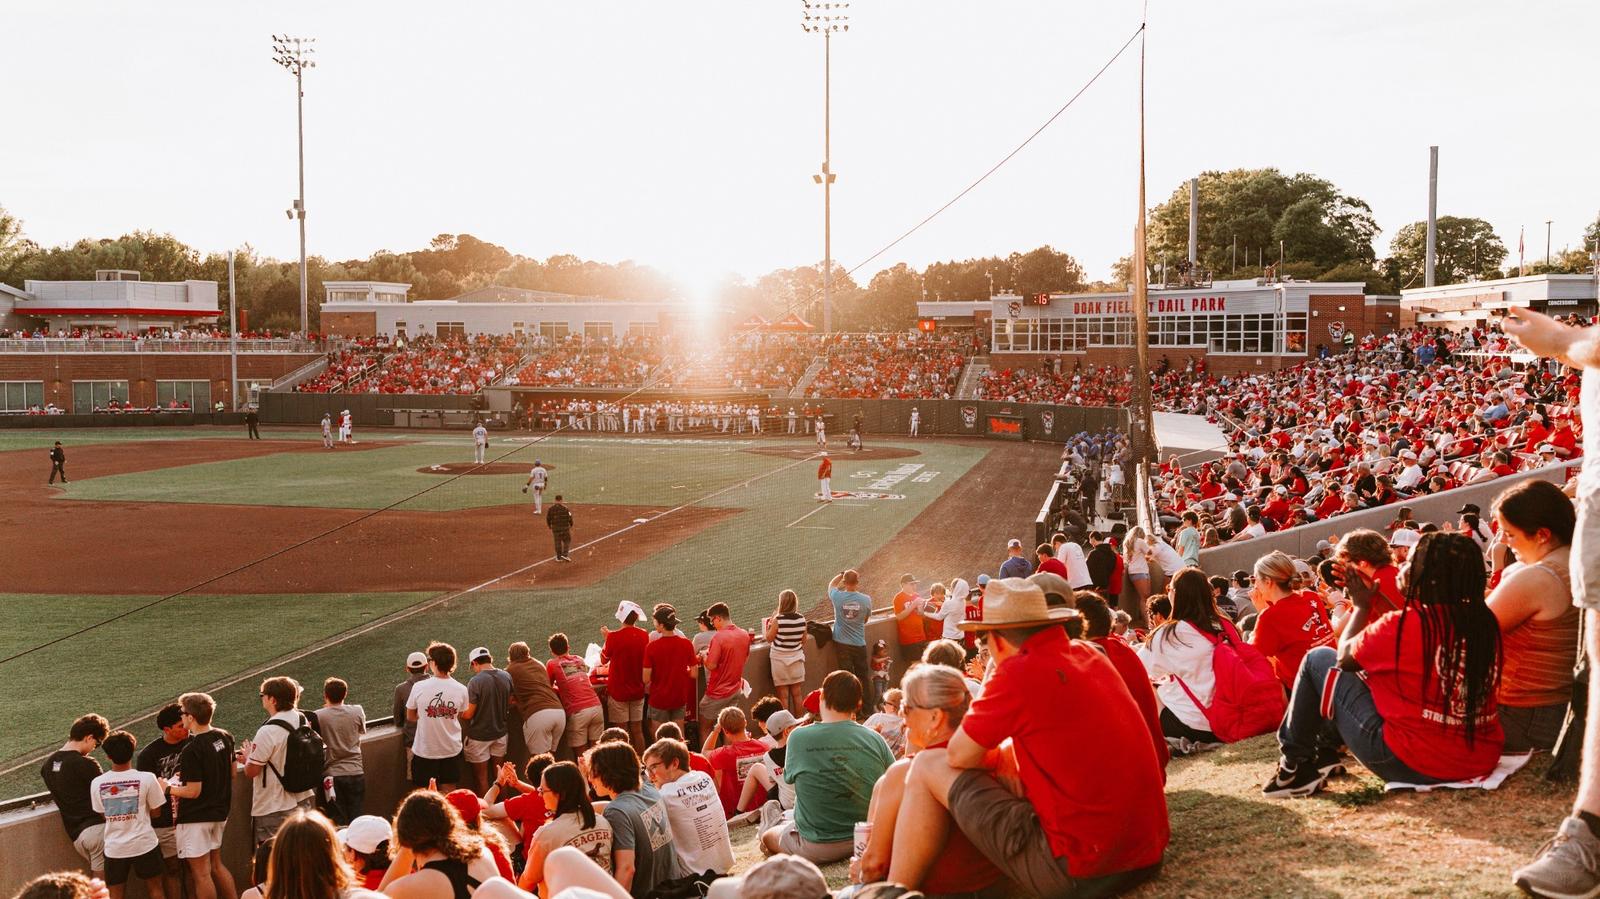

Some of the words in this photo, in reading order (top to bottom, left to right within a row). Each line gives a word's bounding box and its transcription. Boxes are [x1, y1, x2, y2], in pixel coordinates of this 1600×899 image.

[1074, 301, 1101, 314] DOAK
[1106, 301, 1135, 314] FIEL
[1158, 298, 1186, 312] DAIL
[1192, 297, 1226, 311] PARK
